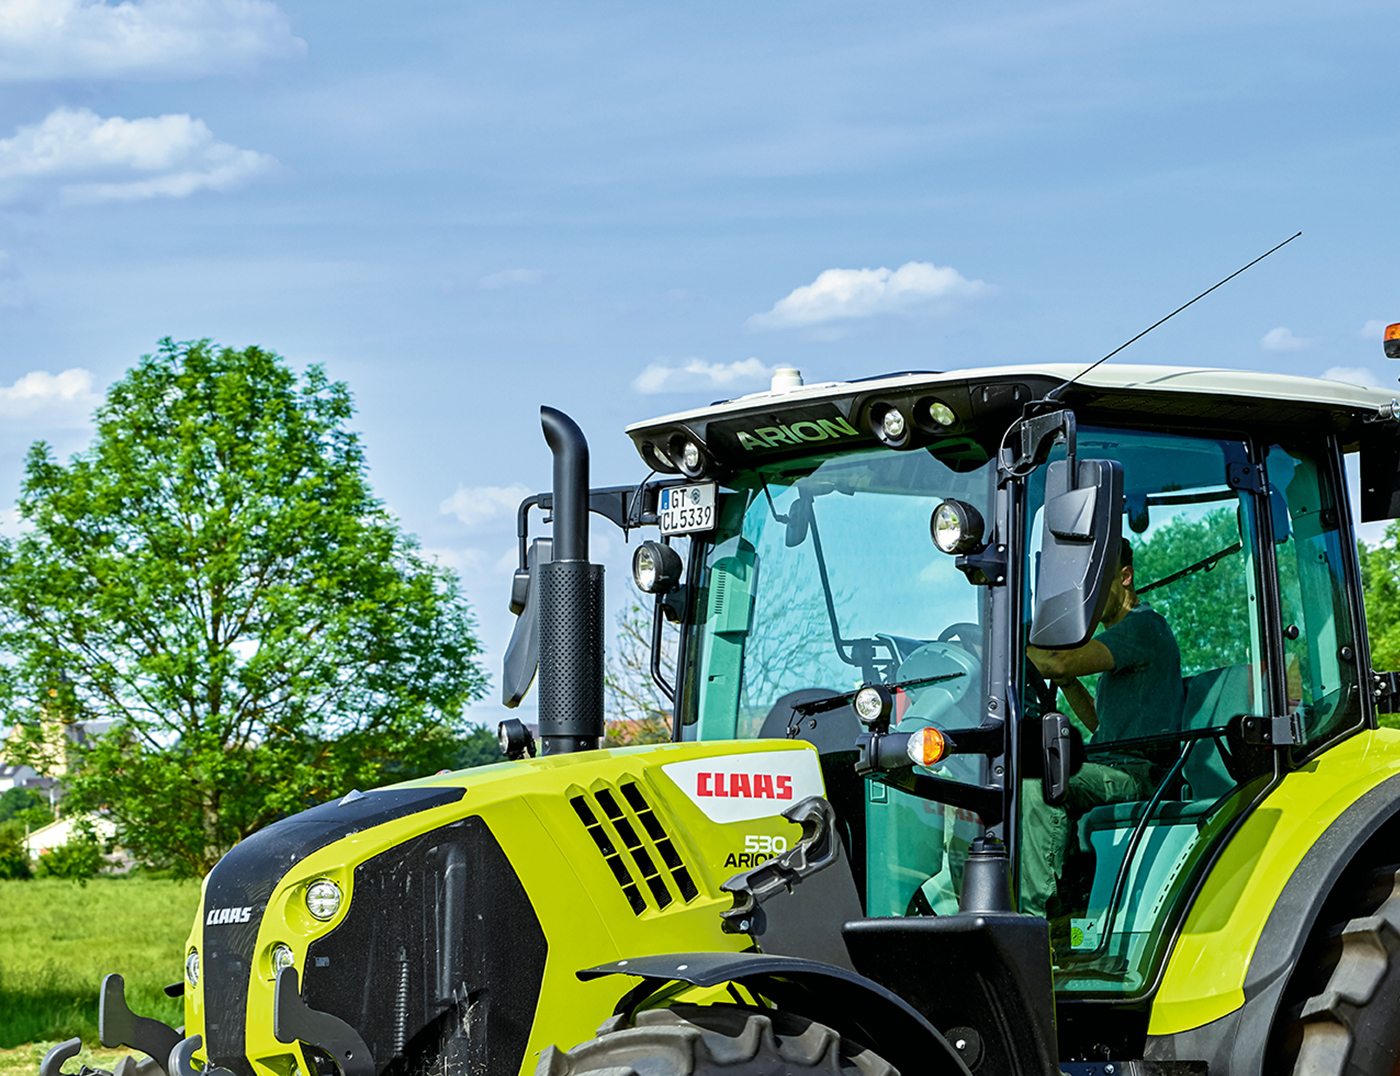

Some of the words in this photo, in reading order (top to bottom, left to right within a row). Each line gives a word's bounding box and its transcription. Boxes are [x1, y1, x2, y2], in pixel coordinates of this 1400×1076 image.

[736, 416, 860, 450] ARION
[671, 489, 687, 509] GT
[697, 772, 793, 800] CLAAS
[744, 835, 787, 853] 530
[206, 906, 253, 926] CLAAS
